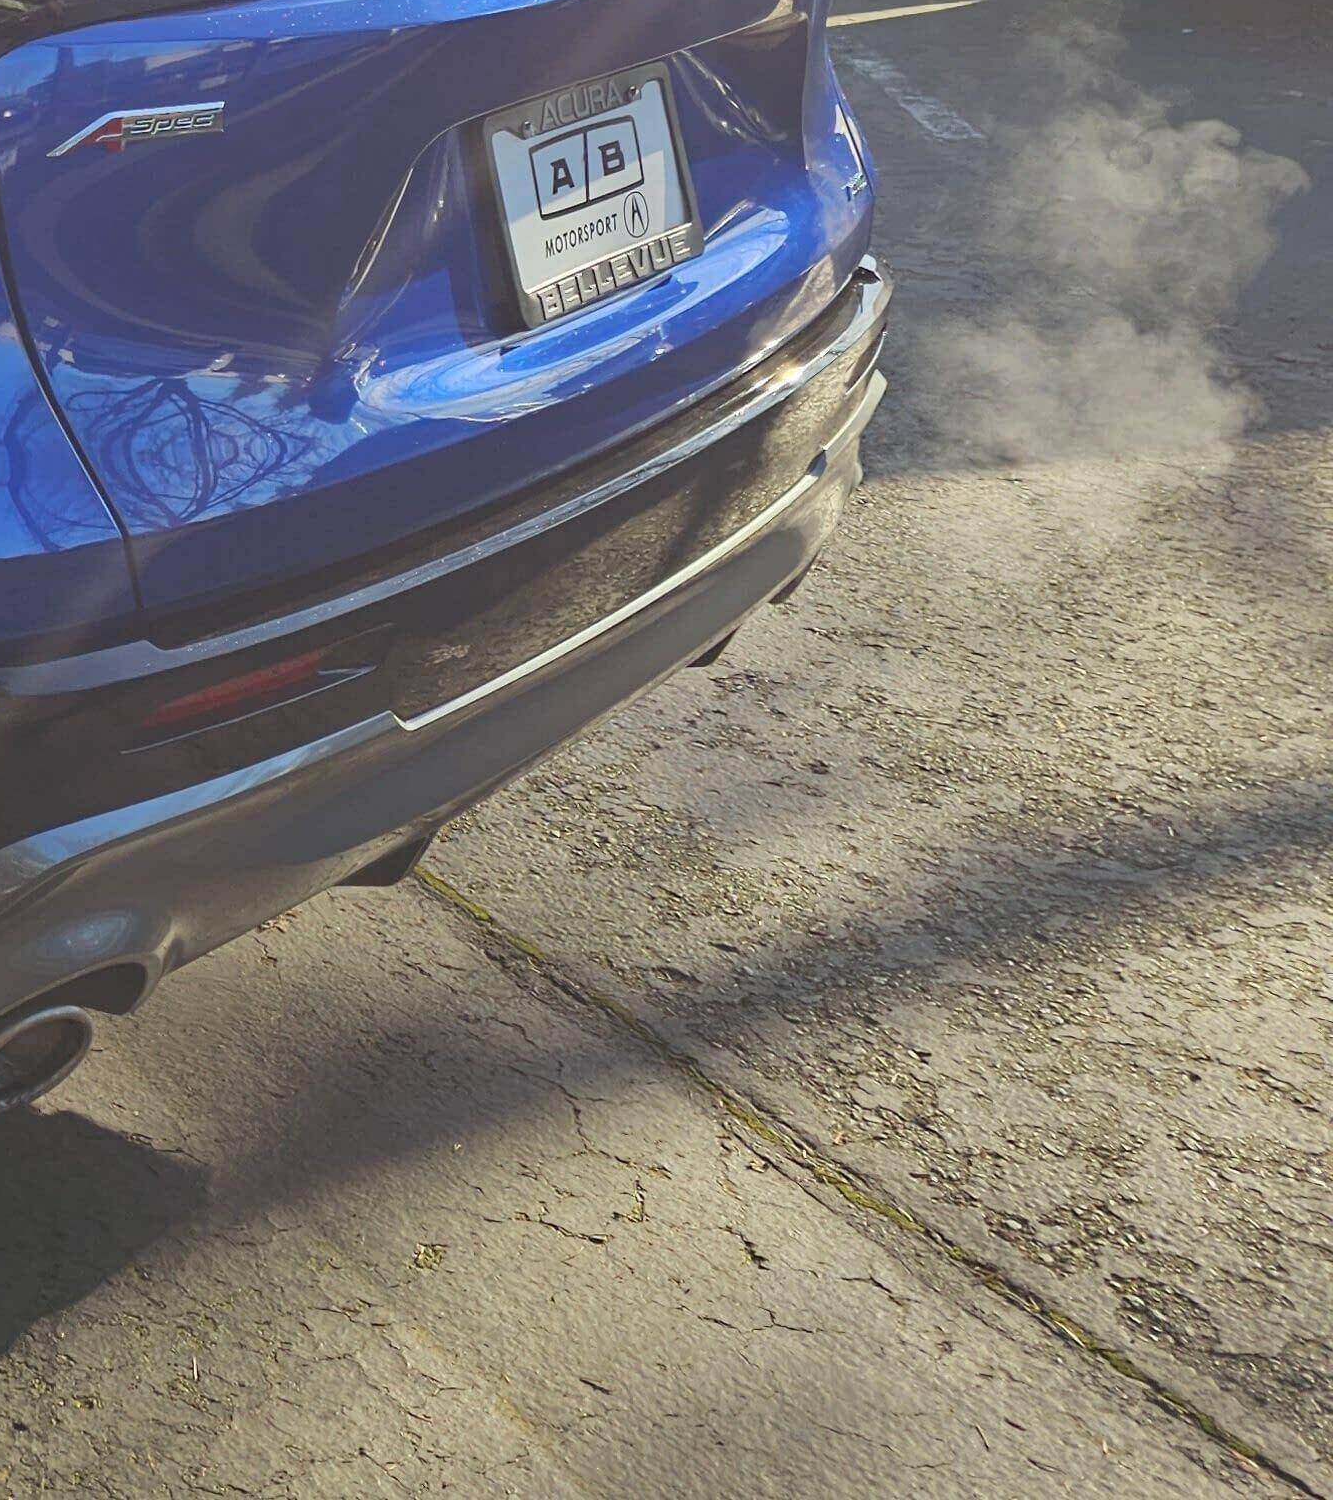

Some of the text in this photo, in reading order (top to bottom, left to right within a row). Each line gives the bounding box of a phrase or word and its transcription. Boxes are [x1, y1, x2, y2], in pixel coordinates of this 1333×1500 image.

[540, 82, 624, 129] ACURA
[550, 140, 626, 194] A B
[545, 213, 618, 259] MOTORSPORT
[536, 229, 691, 321] BELLEVUE
